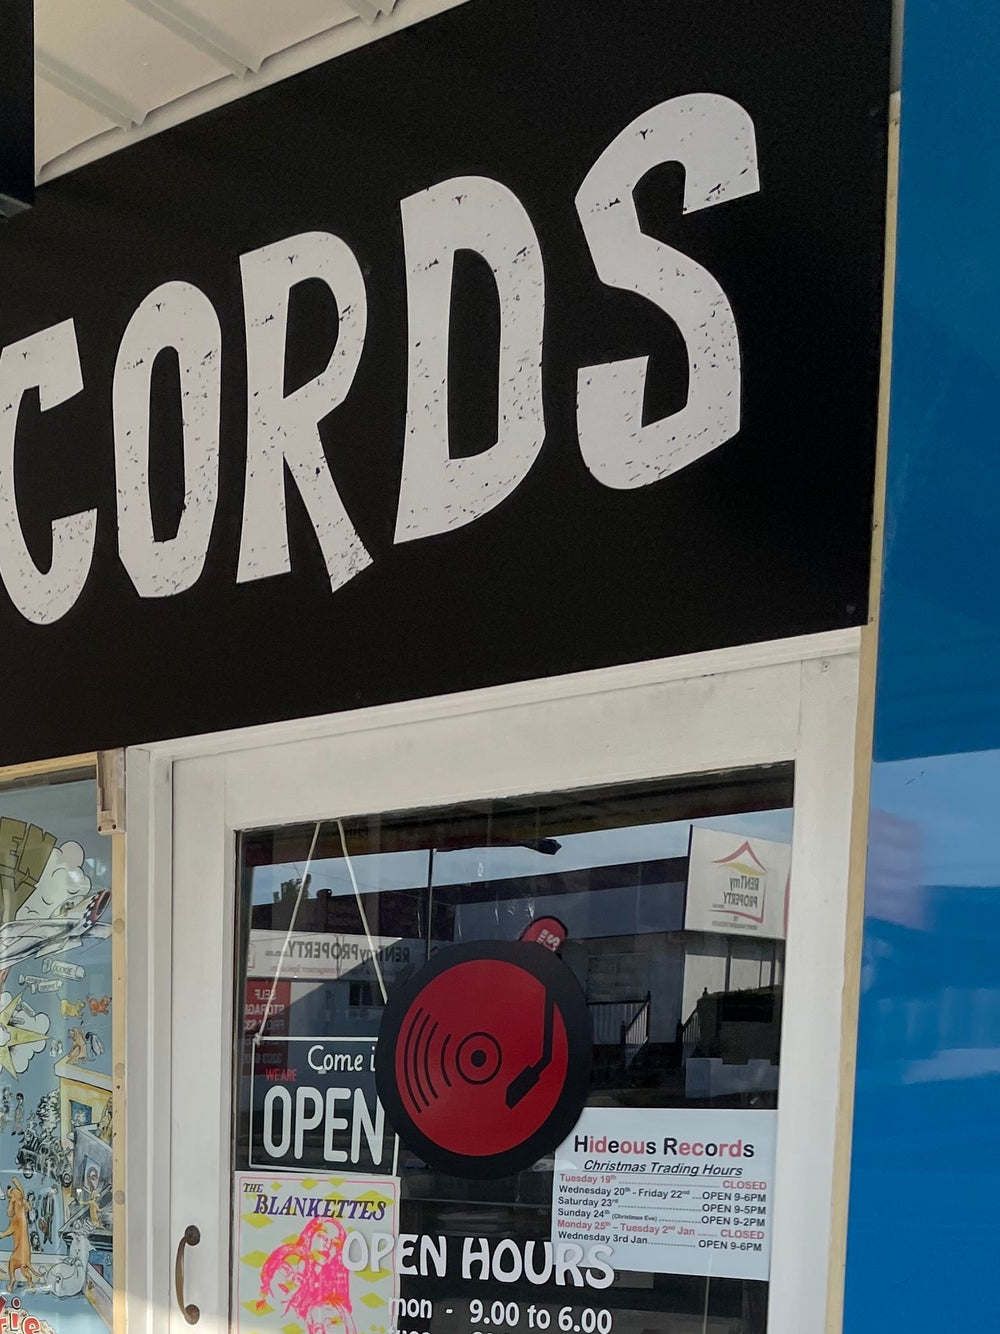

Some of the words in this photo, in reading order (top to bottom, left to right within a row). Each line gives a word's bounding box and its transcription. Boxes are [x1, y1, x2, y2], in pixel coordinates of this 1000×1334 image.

[307, 1045, 362, 1071] Come
[263, 1085, 386, 1166] OPEN
[574, 1135, 656, 1154] Hideous
[663, 1137, 754, 1158] Records
[583, 1159, 646, 1173] Christmas
[650, 1162, 700, 1177] Trading
[702, 1164, 743, 1176] Hours
[242, 1182, 263, 1193] THE
[559, 1173, 597, 1184] Tuesday
[722, 1180, 767, 1190] CLOSED
[559, 1185, 611, 1196] Wednesday
[638, 1188, 669, 1199] Friday
[702, 1191, 731, 1201] OPEN
[734, 1193, 767, 1202] 9-6PM
[253, 1193, 387, 1221] BLANKETTES
[558, 1197, 598, 1208] Saturday
[702, 1203, 731, 1213] OPEN
[734, 1205, 766, 1214] 9-5PM
[558, 1208, 591, 1219] Sunday
[701, 1215, 731, 1225] OPEN
[733, 1217, 765, 1227] 9-2PM
[557, 1220, 592, 1231] Monday
[620, 1223, 659, 1235] Tuesday
[677, 1227, 695, 1236] Jan
[720, 1229, 765, 1240] CLOSED
[558, 1230, 611, 1243] Wednesday
[612, 1234, 629, 1243] 3rd
[631, 1235, 648, 1245] Jan
[698, 1240, 728, 1250] OPEN
[730, 1242, 762, 1252] 9-6PM
[341, 1229, 447, 1278] OPEN
[462, 1237, 615, 1290] HOURS
[388, 1297, 433, 1319] mon
[469, 1299, 520, 1326] 9.00
[527, 1304, 550, 1329] to
[558, 1306, 612, 1334] 6.00
